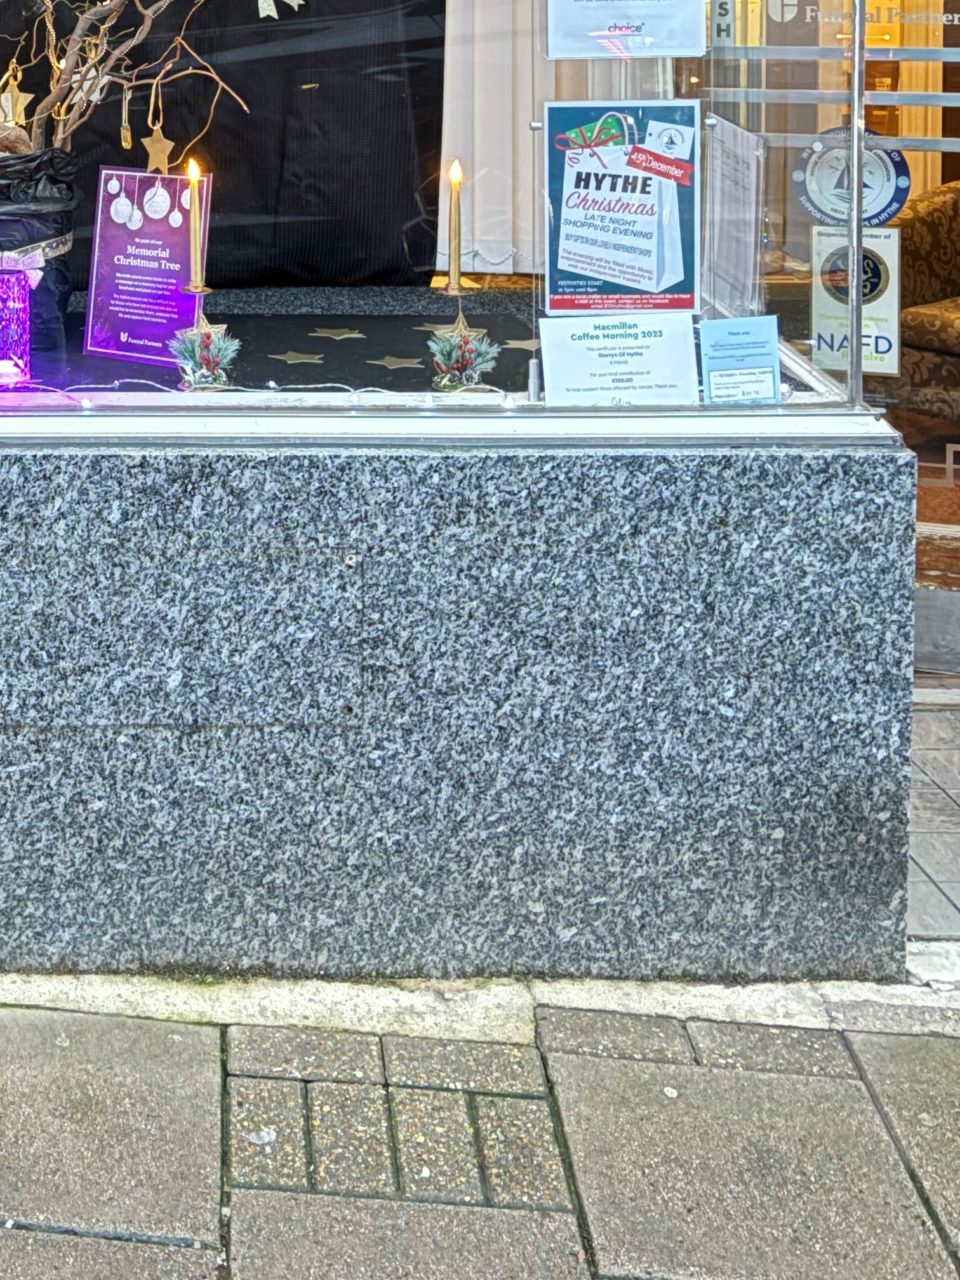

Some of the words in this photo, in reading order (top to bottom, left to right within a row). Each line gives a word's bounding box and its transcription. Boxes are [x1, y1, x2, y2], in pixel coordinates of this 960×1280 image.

[887, 6, 960, 25] Partner
[646, 154, 685, 178] December
[574, 171, 653, 195] HYTHE
[565, 191, 658, 216] Christmas
[562, 218, 611, 233] SHOPPING
[612, 226, 653, 240] EVENING
[584, 213, 607, 223] LATE
[609, 217, 638, 228] NIGHT
[127, 245, 170, 258] Memorial
[114, 255, 159, 269] Christmas
[160, 260, 181, 271] Tree
[593, 322, 638, 331] Macmillan
[570, 332, 600, 341] Coffee
[602, 331, 639, 340] Morning
[641, 330, 663, 339] 2023
